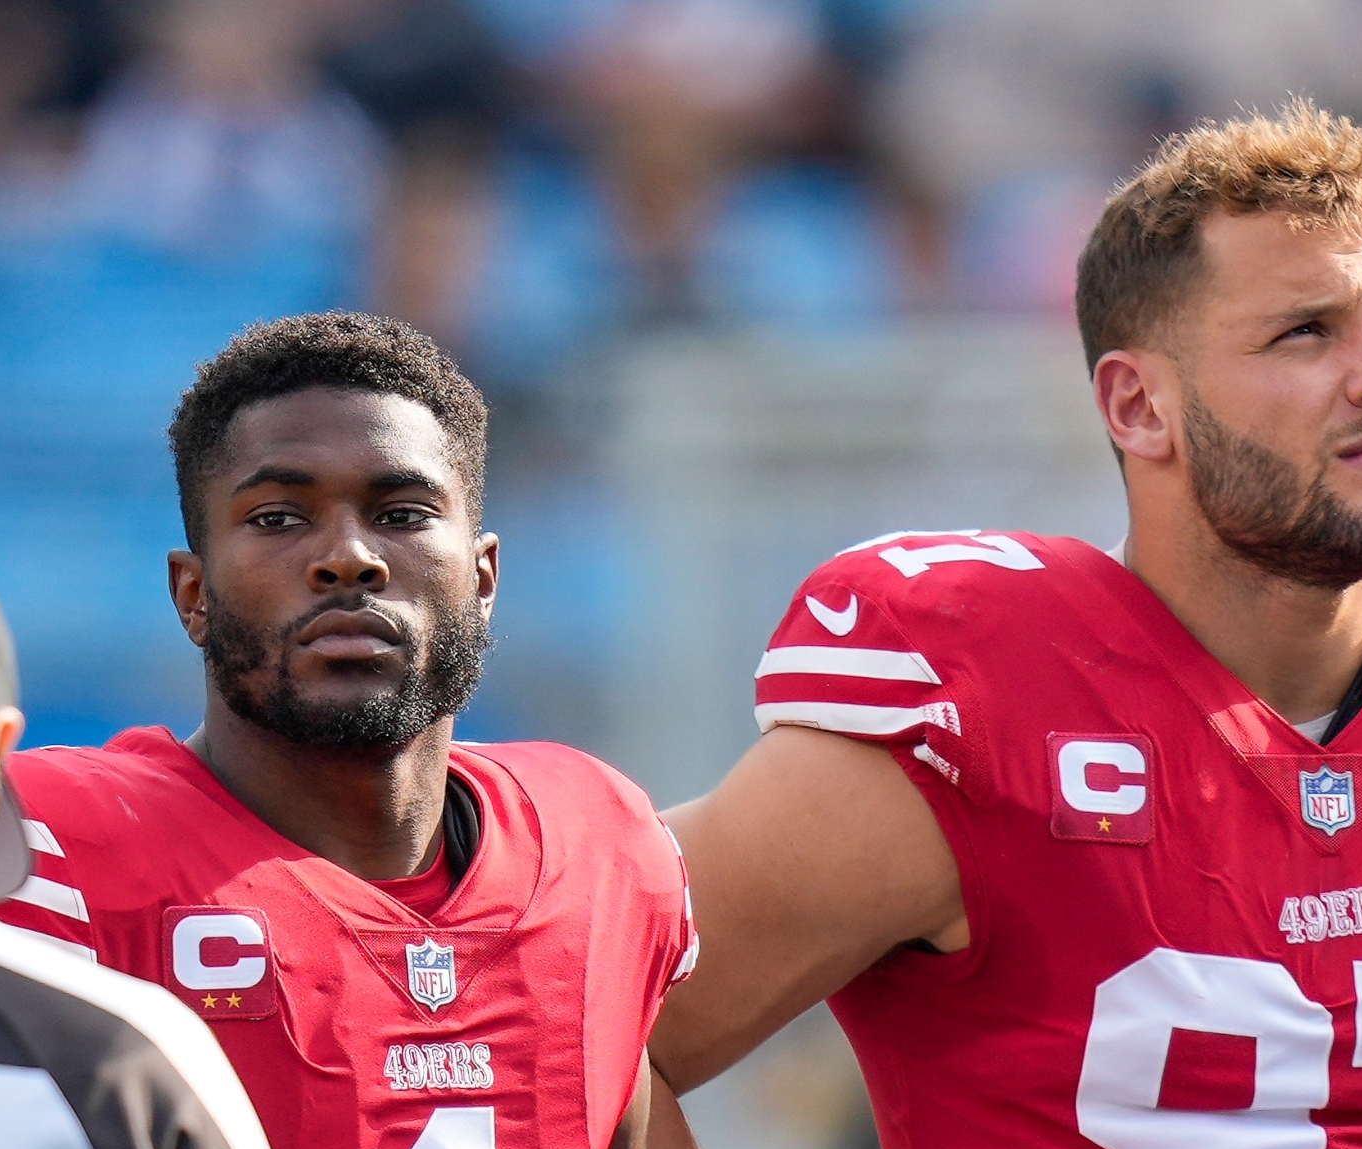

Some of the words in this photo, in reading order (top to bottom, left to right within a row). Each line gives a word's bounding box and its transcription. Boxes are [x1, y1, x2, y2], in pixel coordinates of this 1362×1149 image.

[834, 528, 1046, 579] 7
[1058, 741, 1146, 815] C
[1311, 797, 1347, 822] NFL
[172, 914, 267, 990] C
[416, 970, 450, 998] NFL
[383, 1041, 495, 1090] 49ERS
